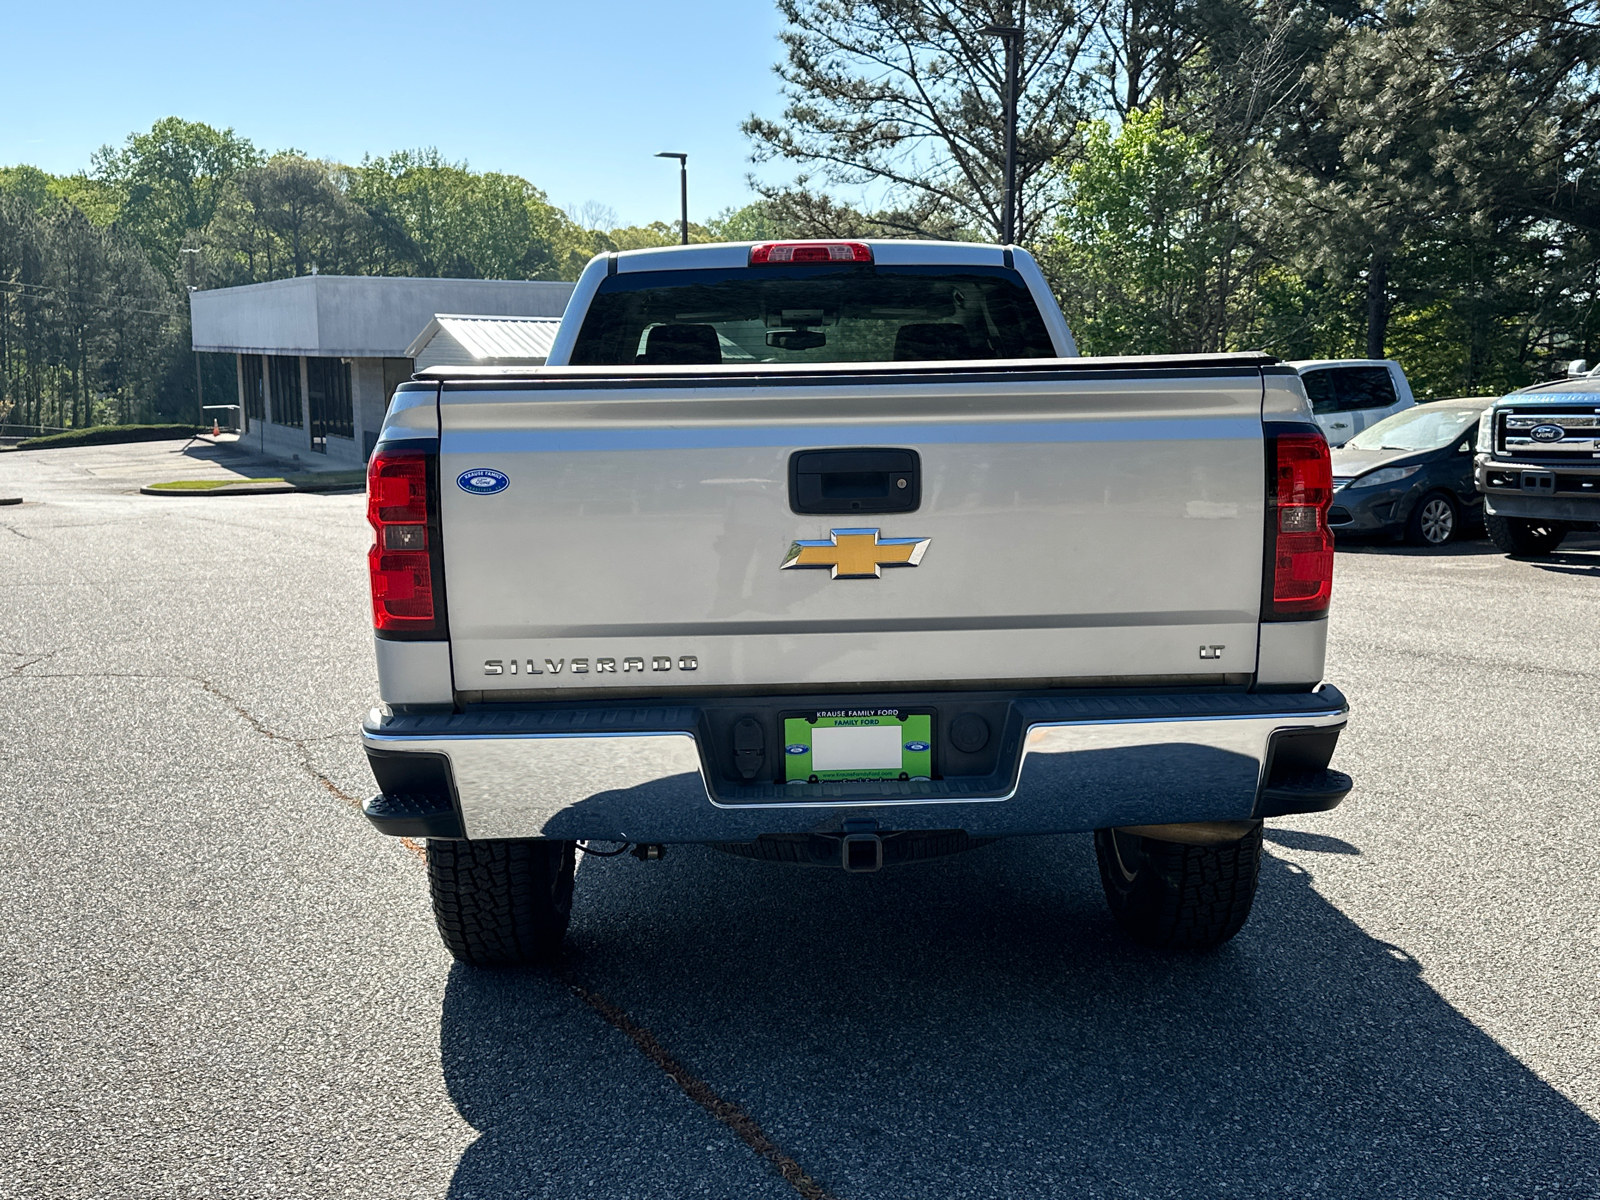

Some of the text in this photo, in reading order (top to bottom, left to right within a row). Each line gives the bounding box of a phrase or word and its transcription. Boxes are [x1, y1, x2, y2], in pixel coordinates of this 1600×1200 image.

[1535, 427, 1556, 438] Ford
[464, 471, 502, 479] KRAUSE FAMILY
[1199, 644, 1226, 660] LT
[484, 655, 699, 676] SILVERADO
[816, 710, 845, 718] KRAUSE
